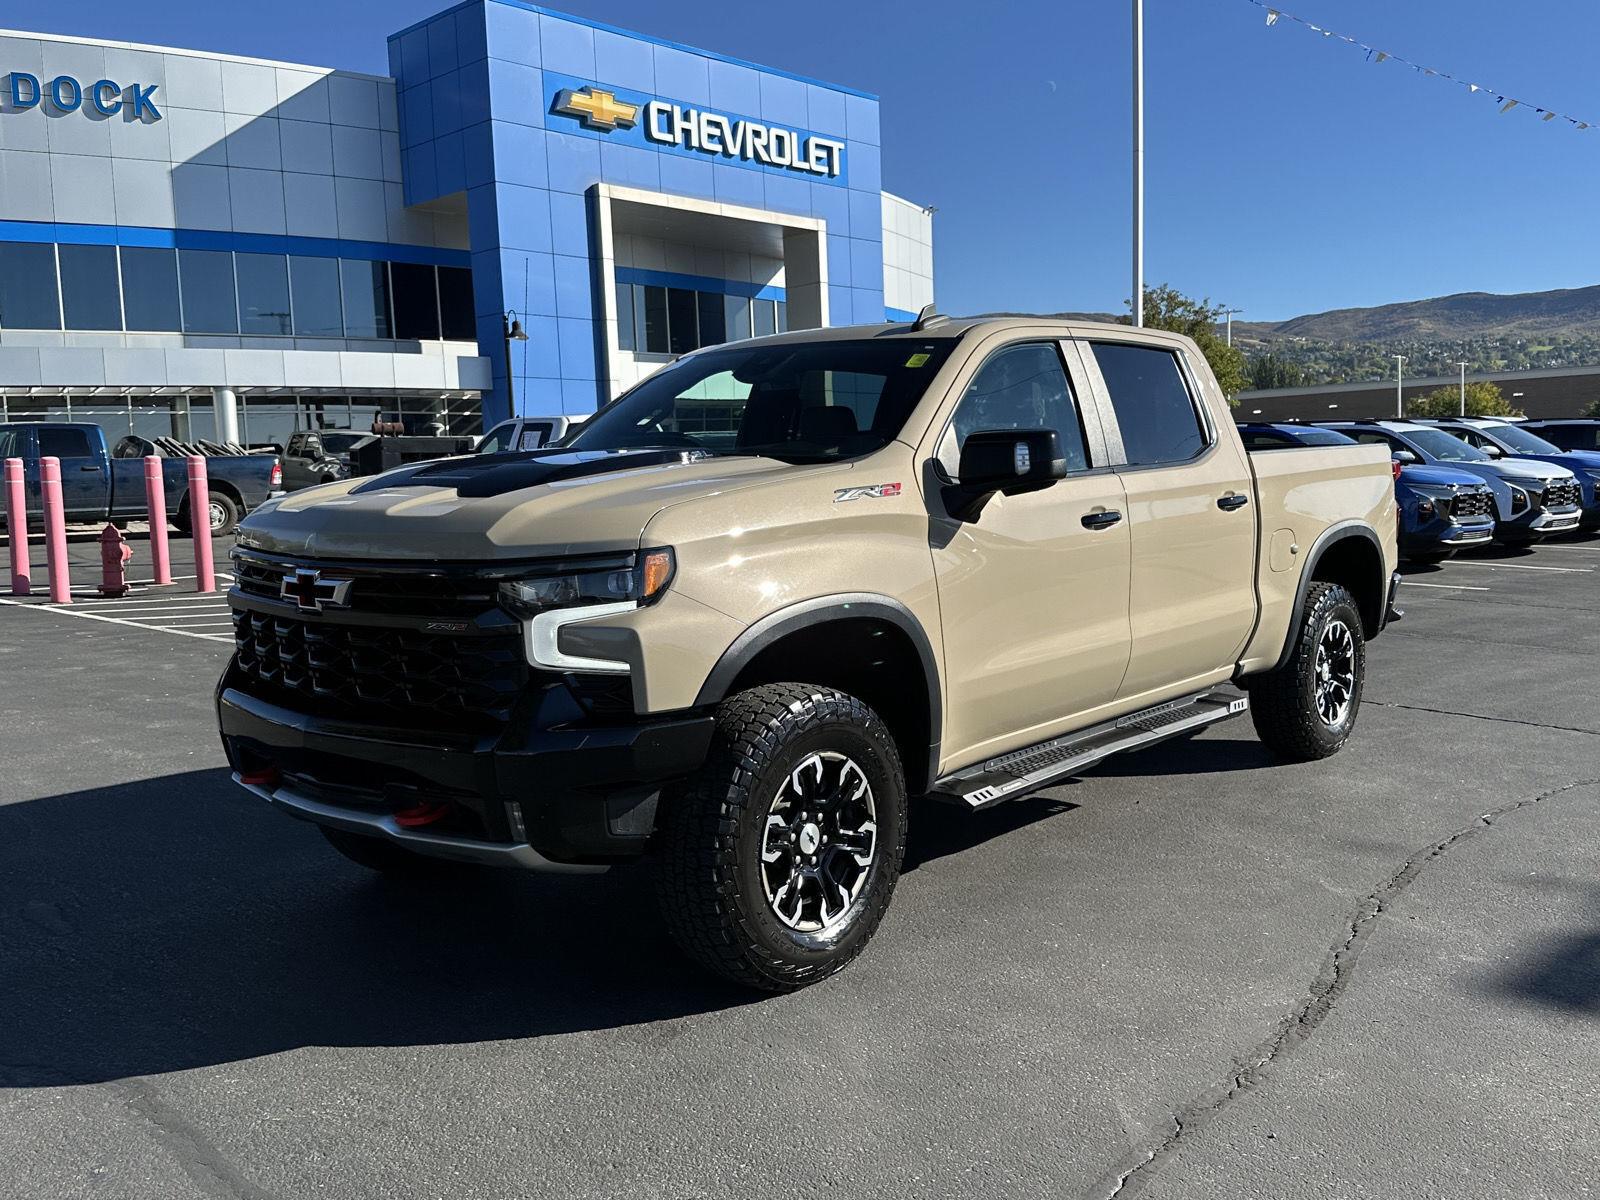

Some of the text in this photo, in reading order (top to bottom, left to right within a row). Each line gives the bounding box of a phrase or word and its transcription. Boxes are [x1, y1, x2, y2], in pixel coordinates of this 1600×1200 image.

[9, 71, 162, 120] DOCK
[647, 99, 845, 177] CHEVROLET
[833, 482, 902, 503] ZR2
